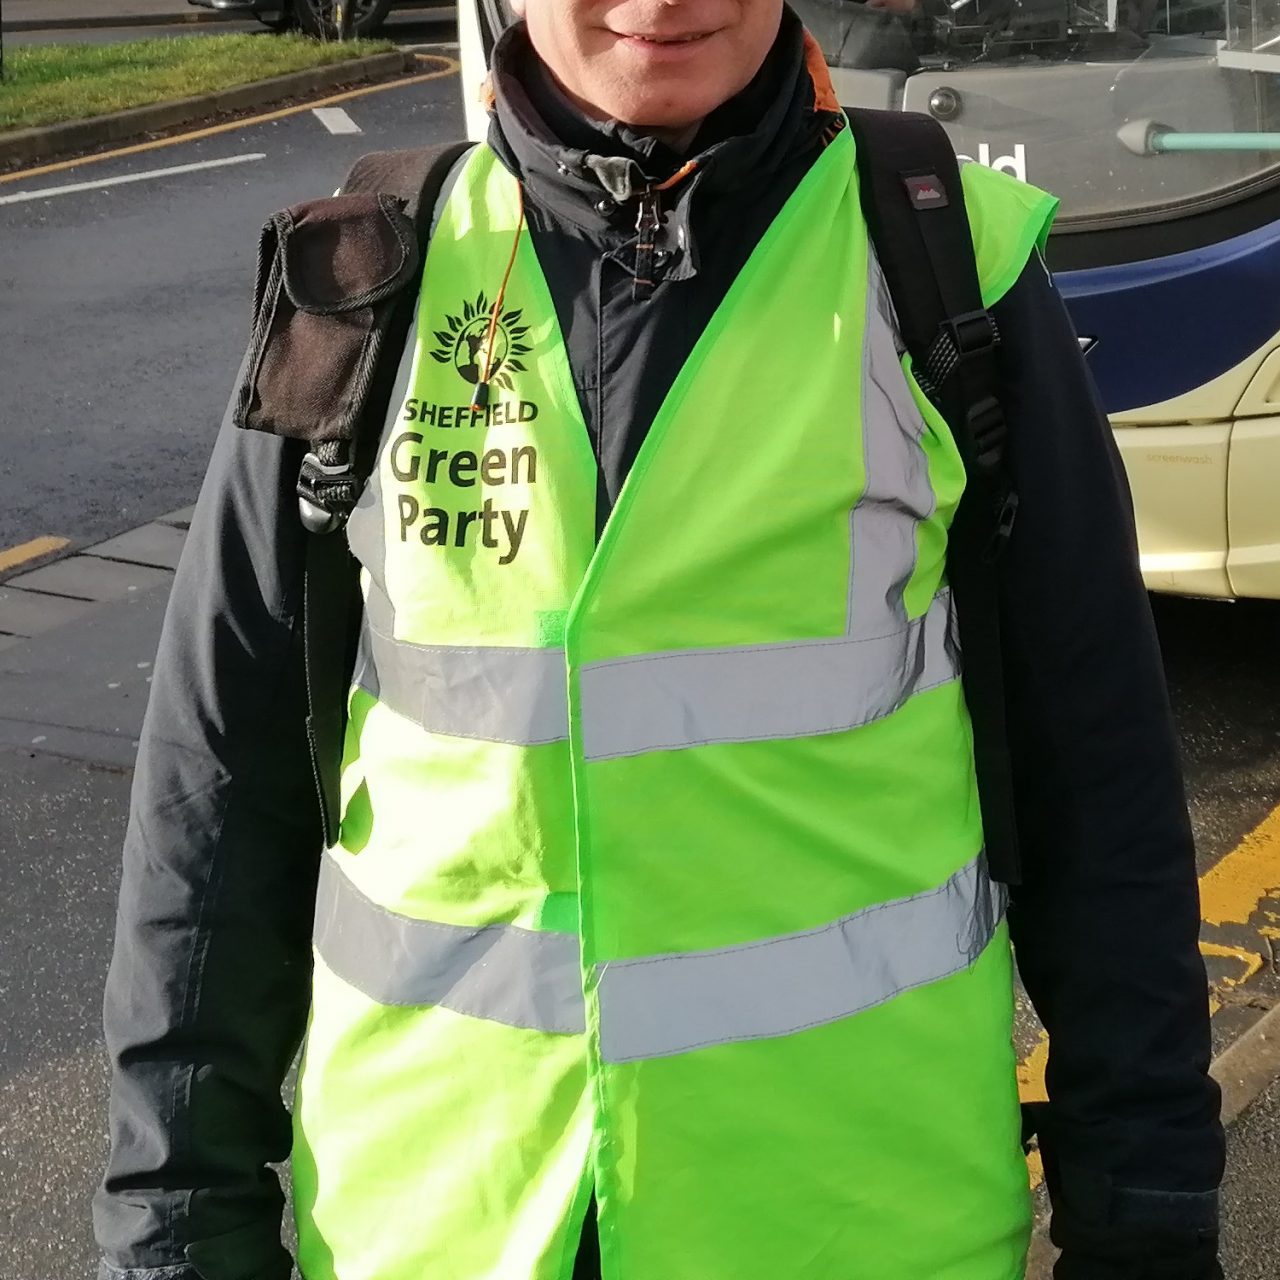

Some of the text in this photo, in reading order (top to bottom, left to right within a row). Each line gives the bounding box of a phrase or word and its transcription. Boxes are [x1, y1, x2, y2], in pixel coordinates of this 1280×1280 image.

[403, 398, 539, 428] SHEFFIELD
[390, 431, 537, 488] Green
[397, 494, 529, 565] Party
